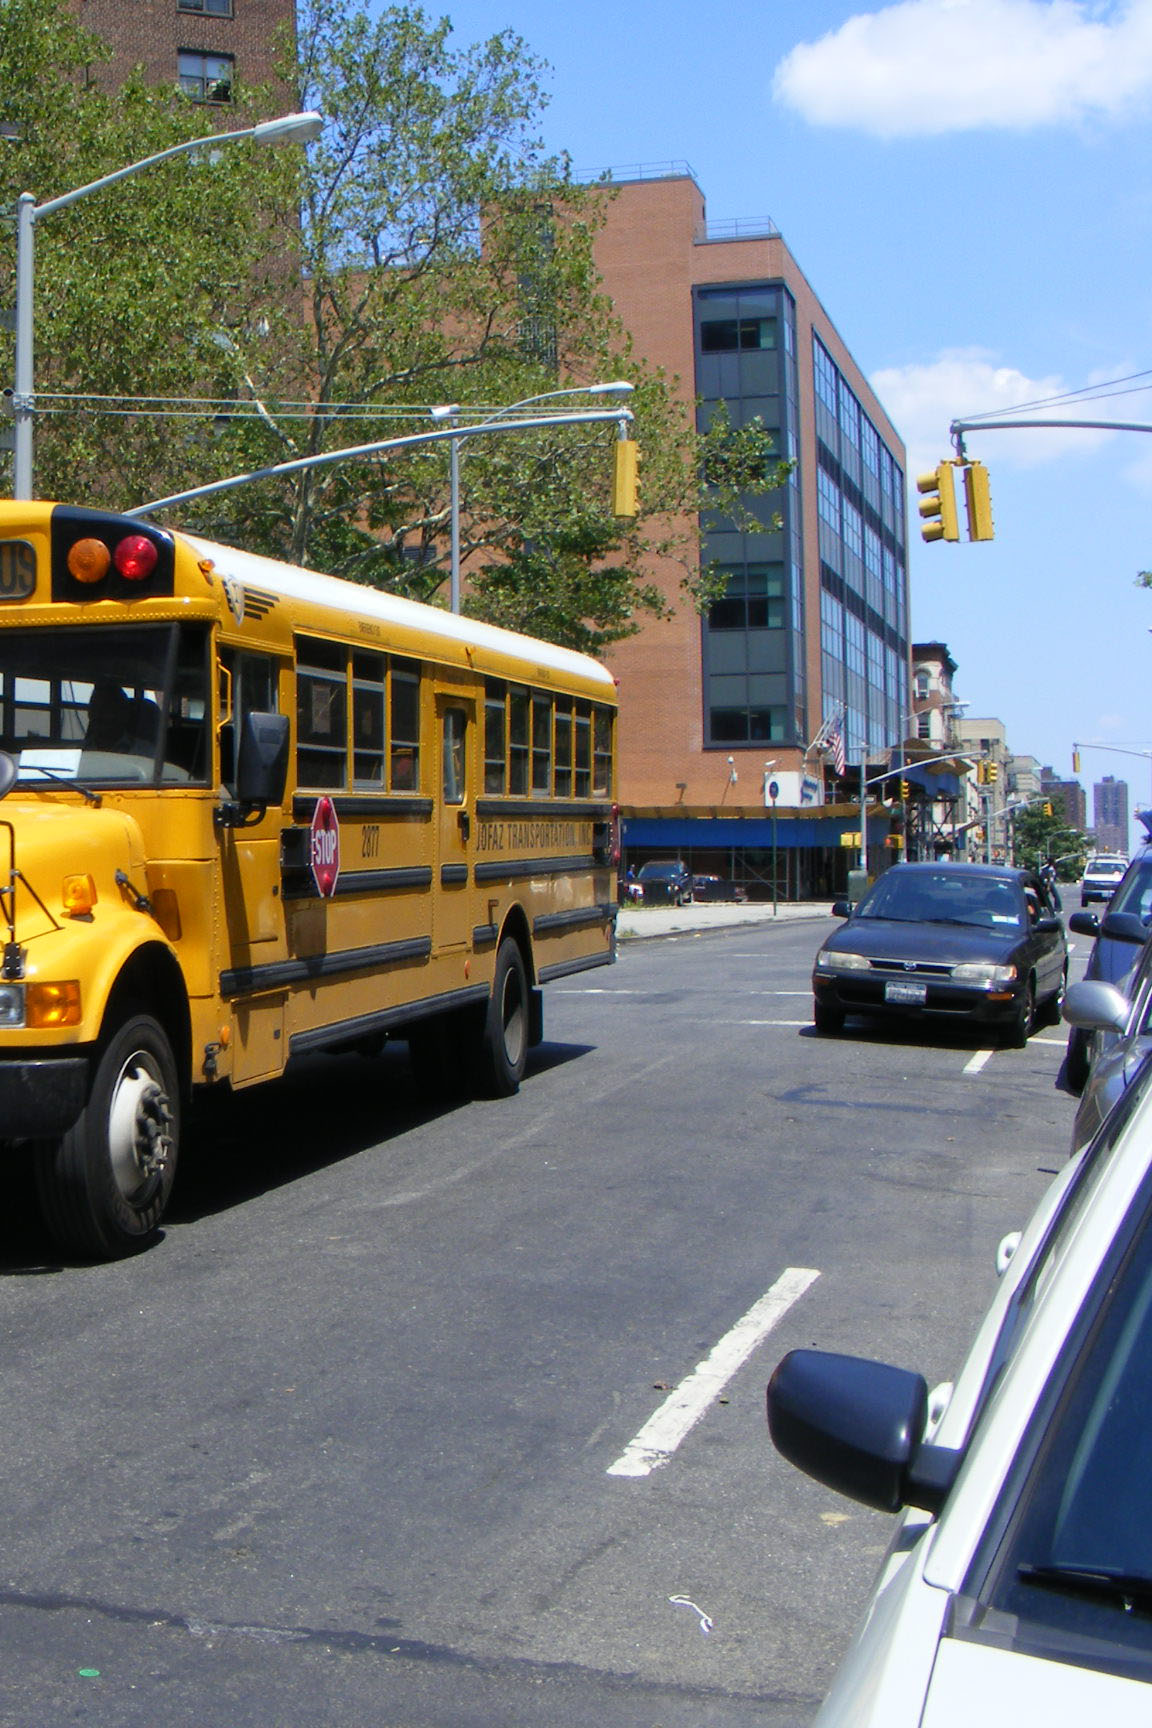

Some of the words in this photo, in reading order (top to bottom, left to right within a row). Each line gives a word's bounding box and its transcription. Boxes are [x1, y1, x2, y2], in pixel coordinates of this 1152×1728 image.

[315, 829, 337, 865] STOP
[362, 825, 380, 858] 2877
[476, 823, 504, 851] JOFAZ
